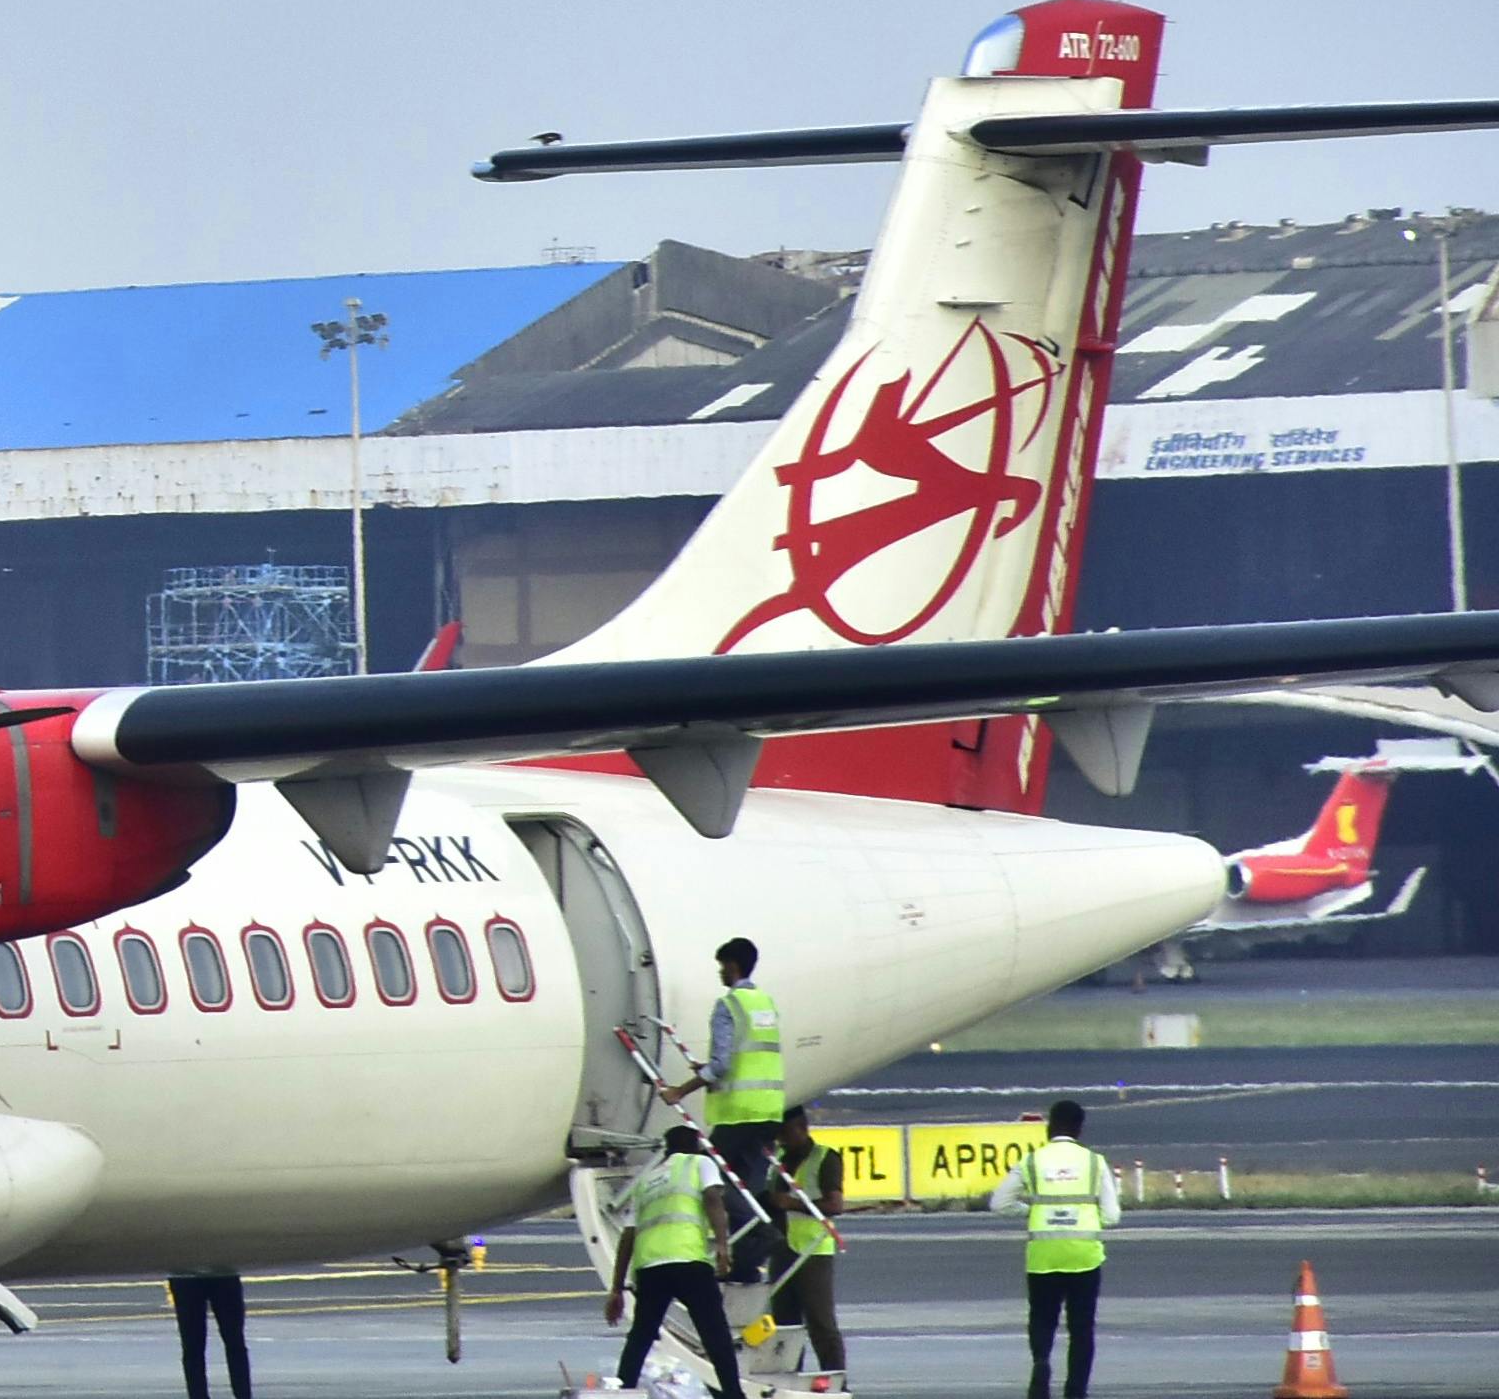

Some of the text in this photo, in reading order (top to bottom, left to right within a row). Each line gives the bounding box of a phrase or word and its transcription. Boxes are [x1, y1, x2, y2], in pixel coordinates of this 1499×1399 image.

[1058, 31, 1091, 60] ATR
[1270, 447, 1366, 466] SERVICES
[300, 836, 501, 886] V-RKK
